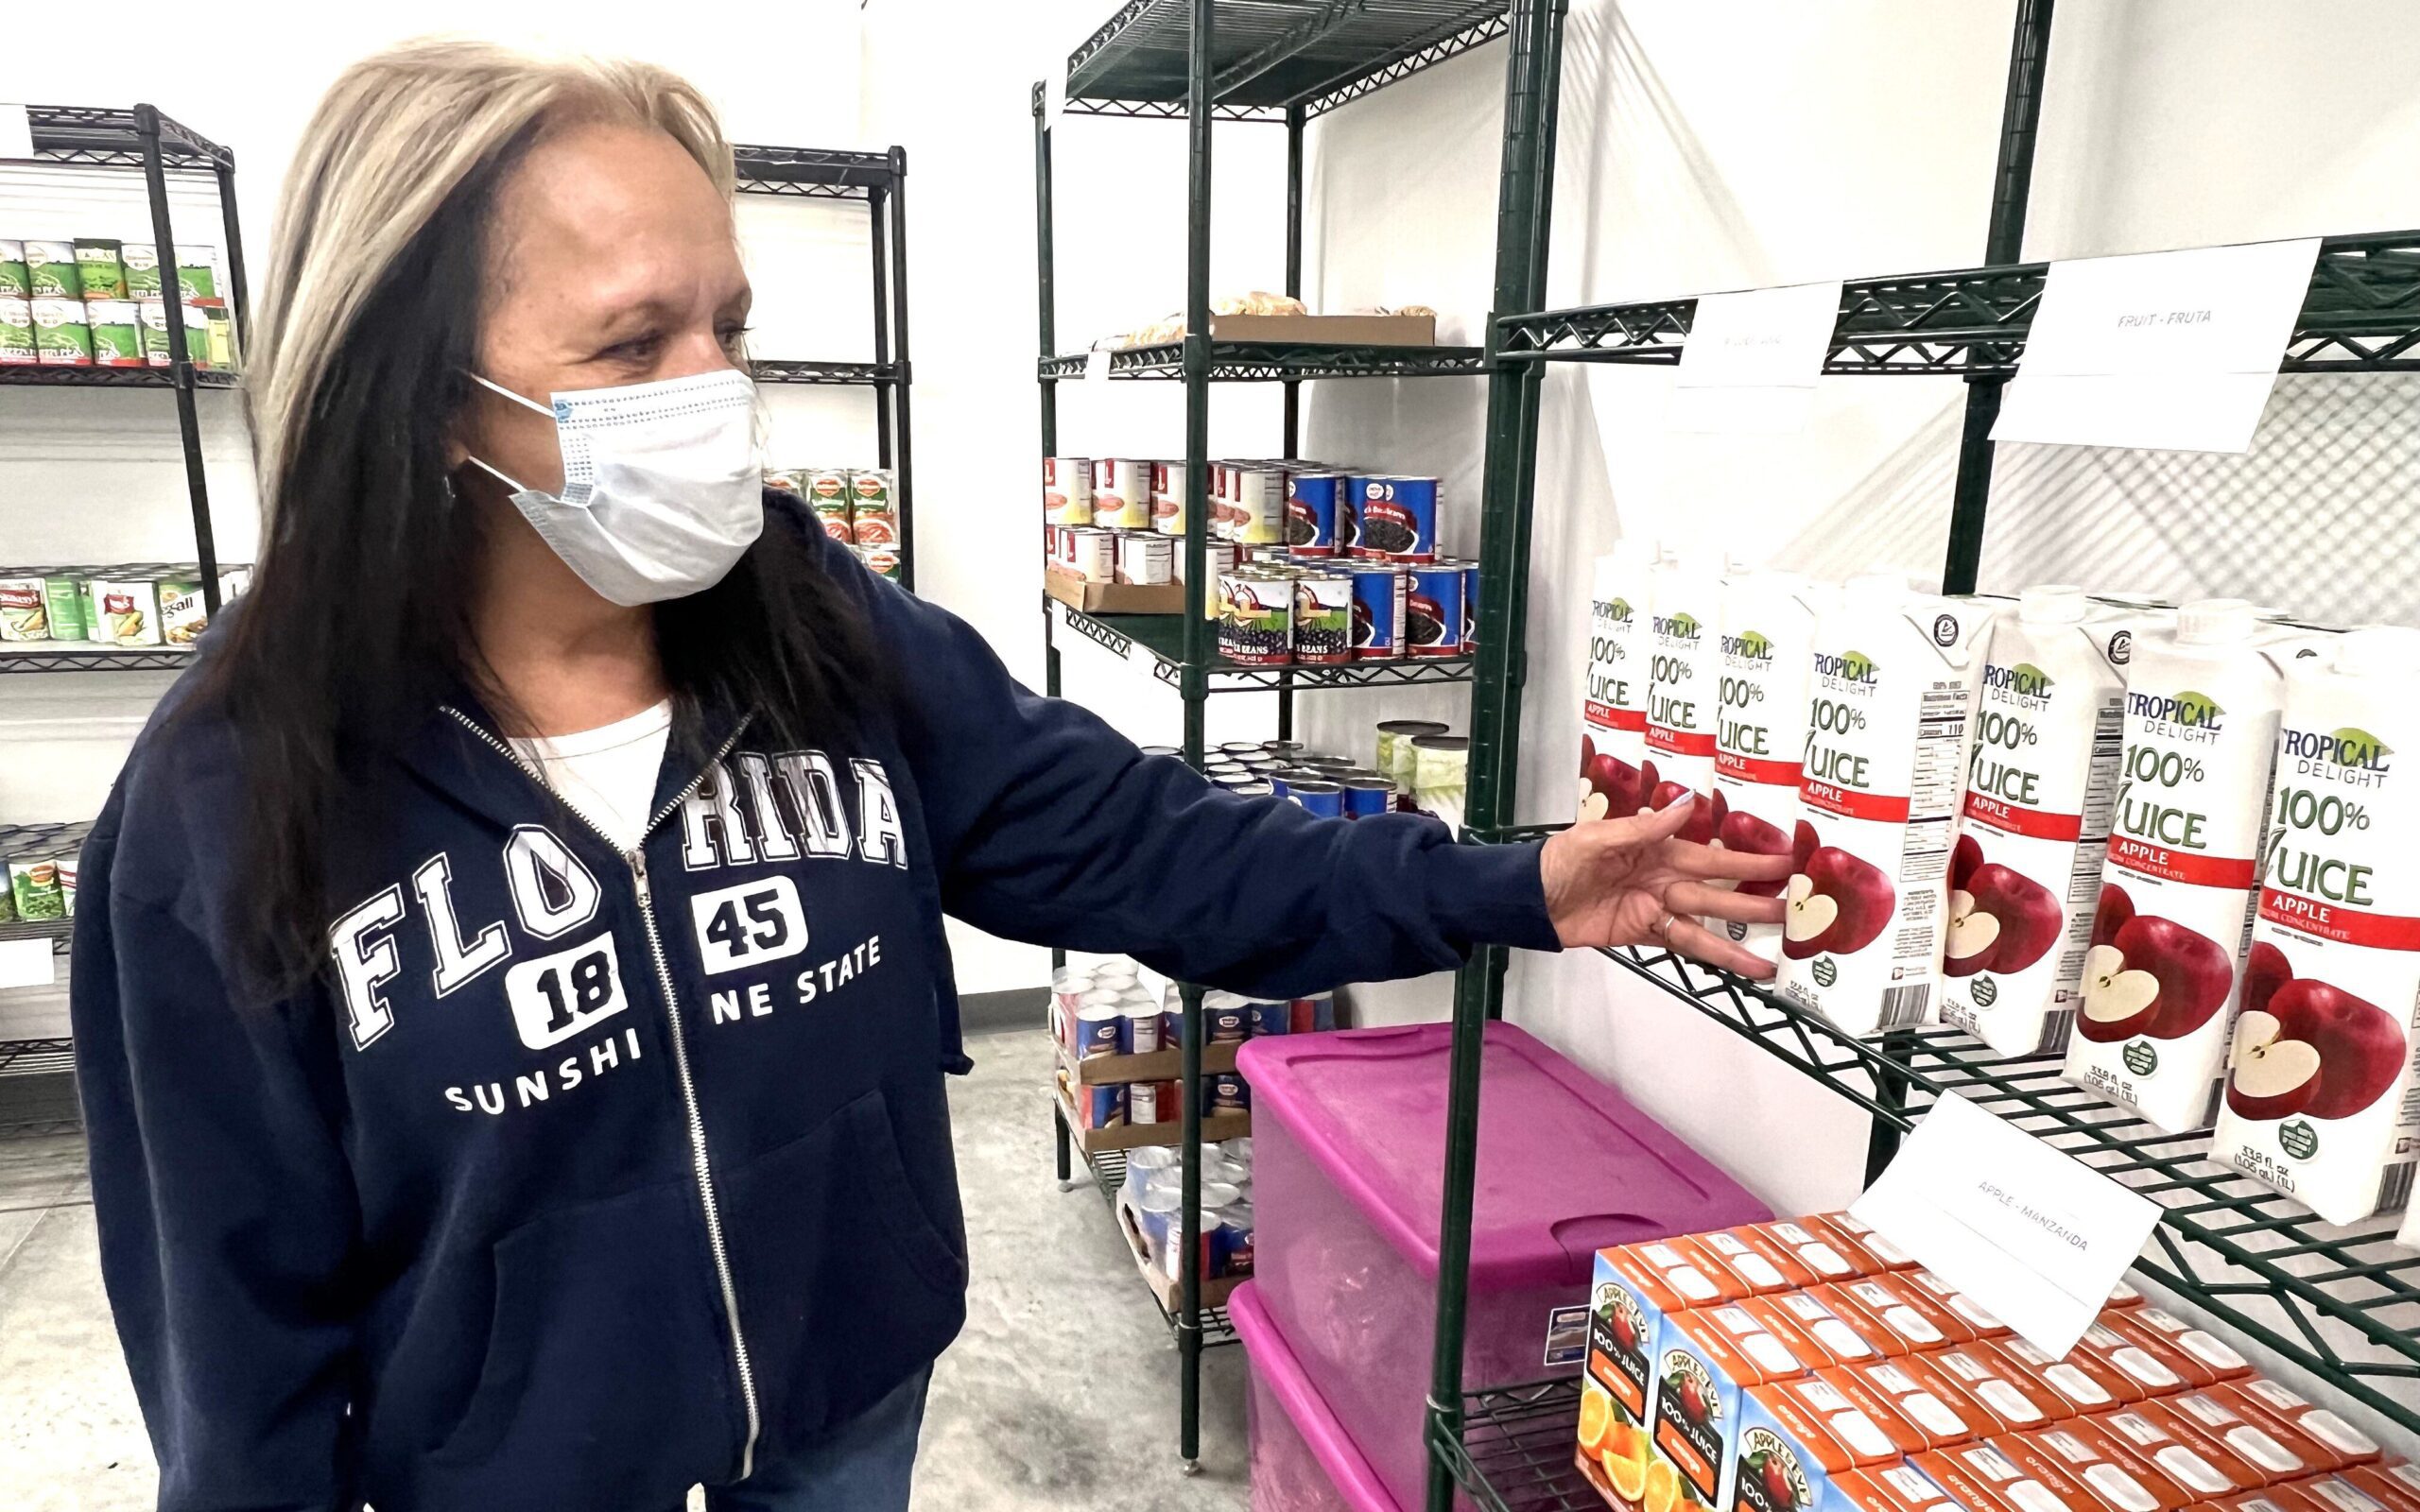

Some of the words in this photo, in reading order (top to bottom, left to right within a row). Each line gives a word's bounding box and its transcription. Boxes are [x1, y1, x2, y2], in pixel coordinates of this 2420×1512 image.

[2118, 314, 2157, 328] FRUIT
[2167, 310, 2212, 325] FRUTA
[1590, 636, 1626, 664] 100%
[1725, 655, 1772, 672] DELIGHT
[1651, 654, 1692, 685] 100%
[1719, 676, 1764, 709] 100%
[1822, 676, 1876, 697] DELIGHT
[1992, 688, 2049, 712] DELIGHT
[1810, 697, 1866, 735] 100%
[2127, 692, 2222, 730] TROPICAL
[1948, 724, 1963, 736] 110
[1977, 710, 2037, 750] 100%
[2144, 720, 2221, 746] DELIGHT
[1719, 753, 1746, 770] APPLE
[2124, 744, 2204, 787] 100%
[2297, 759, 2388, 788] DELIGHT
[1806, 782, 1843, 802] APPLE
[1973, 796, 2011, 819] APPLE
[2277, 786, 2371, 836] 100%
[2118, 841, 2169, 865] APPLE
[706, 887, 789, 959] 45
[2272, 894, 2332, 923] APPLE
[328, 823, 601, 1052] FLO
[536, 949, 614, 1034] 18
[710, 983, 774, 1026] NE
[799, 935, 881, 1006] STATE
[445, 1027, 641, 1116] SUNSHI
[1978, 1180, 2014, 1207] APPLE
[2020, 1206, 2089, 1252] MANZANDA
[1621, 1354, 1645, 1387] JUICE
[1690, 1427, 1719, 1465] JUICE
[2026, 1456, 2074, 1495] orange
